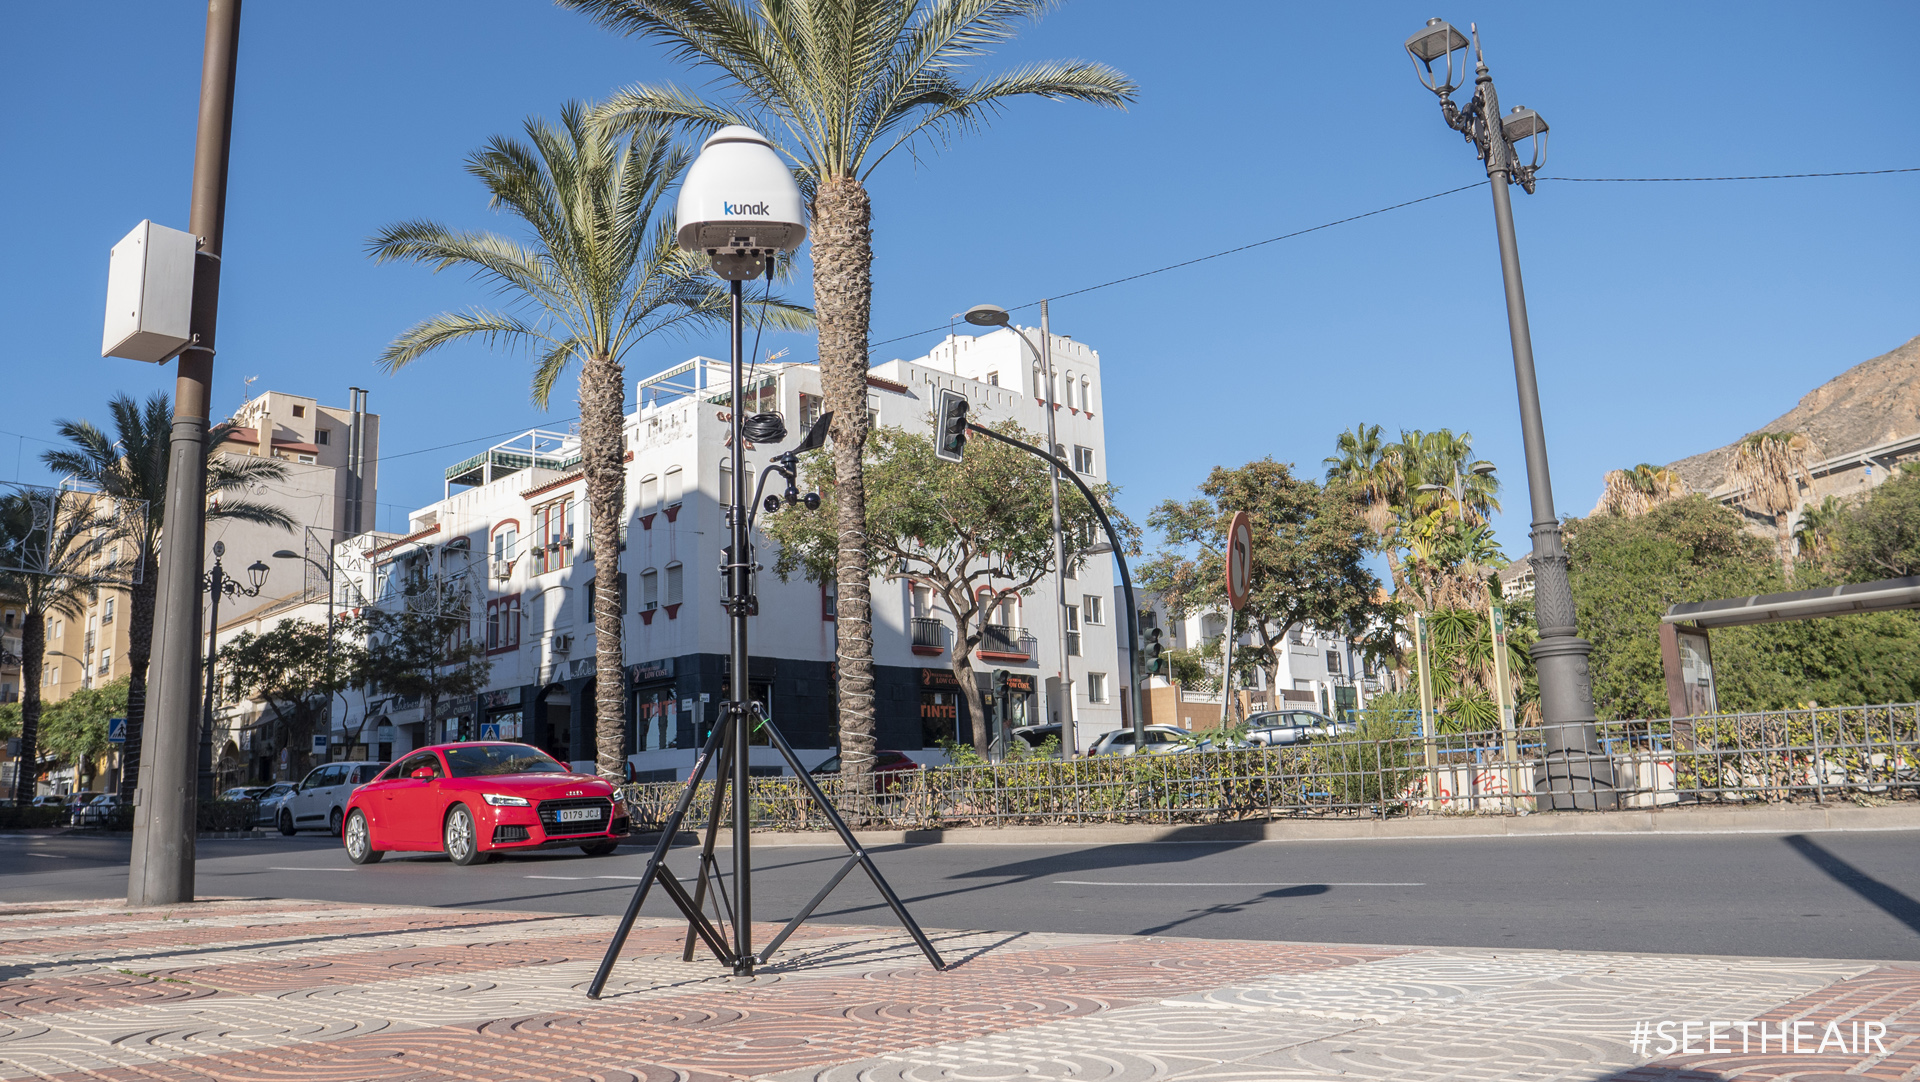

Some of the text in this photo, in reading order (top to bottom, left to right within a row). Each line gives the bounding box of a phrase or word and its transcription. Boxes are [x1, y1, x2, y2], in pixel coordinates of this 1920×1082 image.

[724, 201, 770, 216] kunak
[655, 669, 668, 678] COST
[921, 705, 956, 718] TINTE
[563, 809, 599, 820] 0179 JCJ
